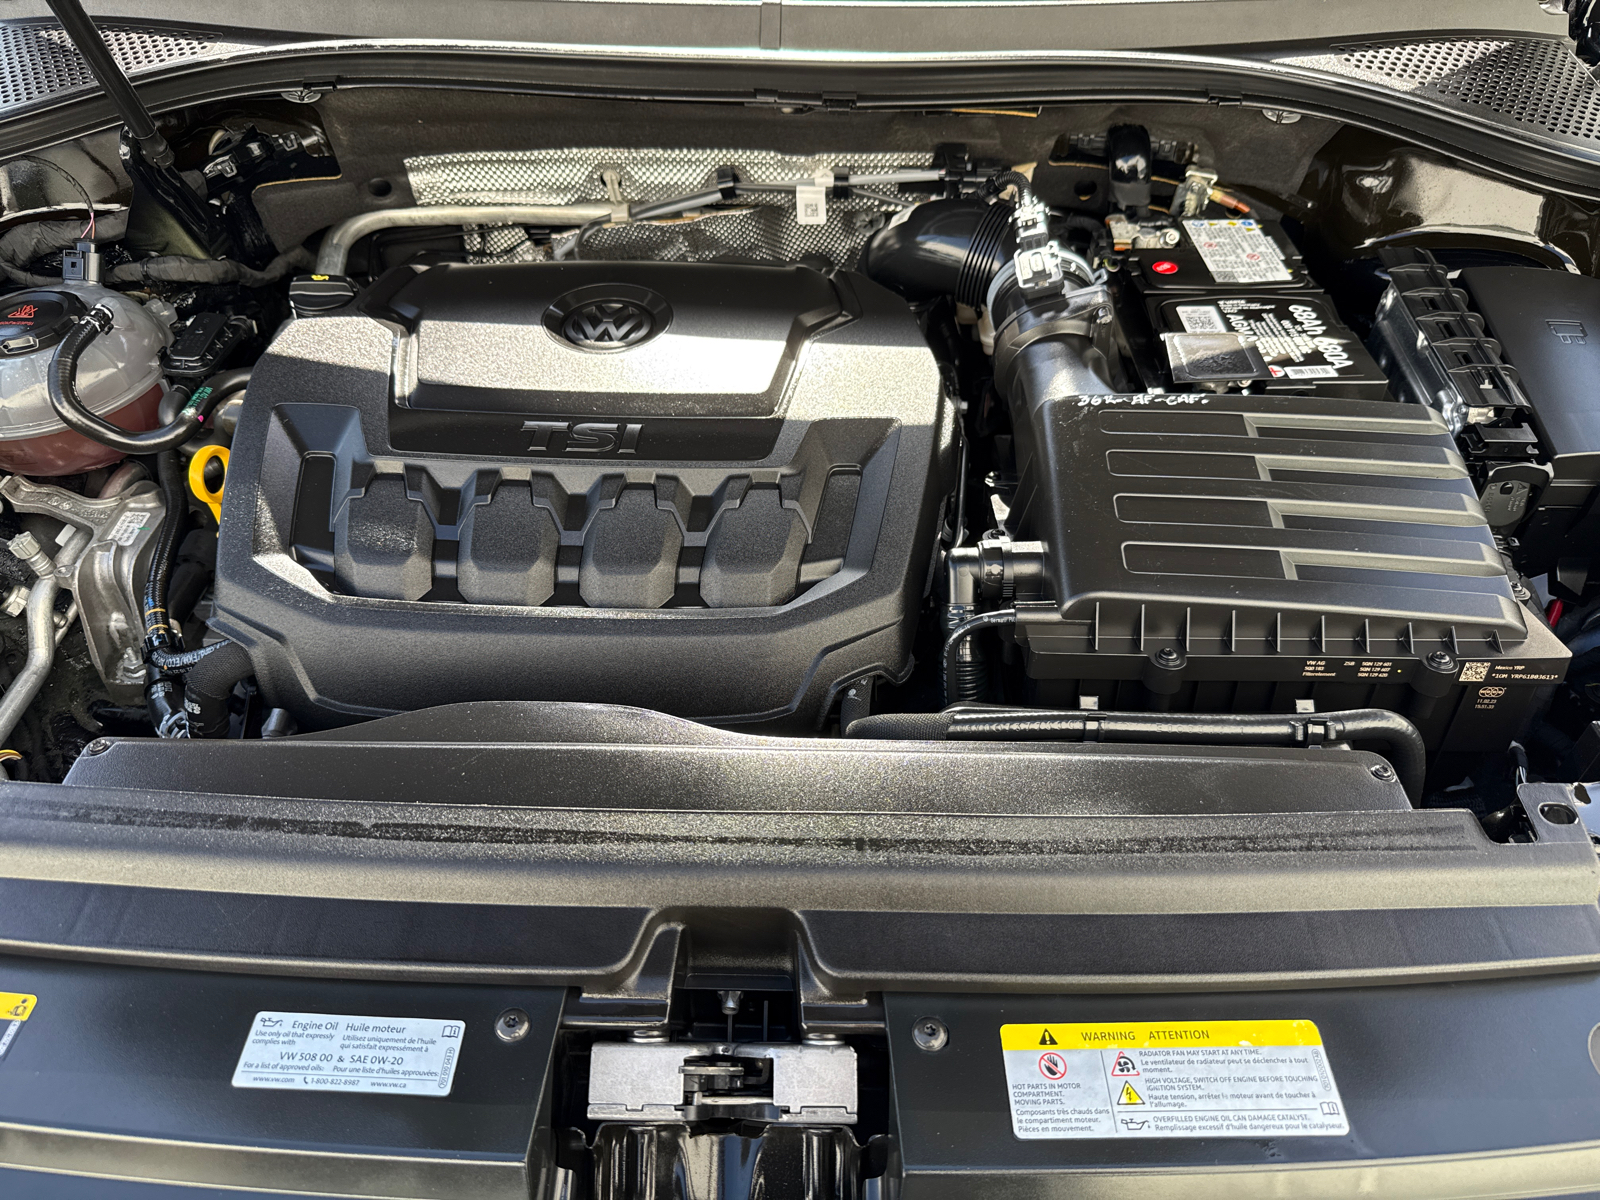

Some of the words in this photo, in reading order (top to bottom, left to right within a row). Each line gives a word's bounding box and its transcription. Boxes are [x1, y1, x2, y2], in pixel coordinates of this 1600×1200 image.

[1288, 304, 1327, 336] 68Ah
[1312, 336, 1354, 370] 680A
[520, 420, 645, 454] TSI
[292, 1020, 323, 1031] Engine
[324, 1022, 339, 1030] Oil
[346, 1023, 370, 1032] Huile
[371, 1025, 406, 1033] moteur
[268, 1030, 282, 1038] only
[305, 1032, 335, 1041] expressly
[342, 1034, 366, 1042] Utilisez
[367, 1036, 406, 1044] uniquement
[417, 1037, 436, 1045] l'huile
[1081, 1031, 1136, 1041] WARNING
[1149, 1030, 1210, 1040] ATTENTION
[252, 1038, 280, 1046] complies
[340, 1042, 351, 1050] qui
[378, 1044, 424, 1052] expressément
[280, 1052, 298, 1060] VW
[299, 1052, 318, 1061] 508
[319, 1053, 333, 1062] 00
[349, 1055, 369, 1064] SAE
[370, 1056, 404, 1065] 0W-20
[280, 1063, 310, 1071] approved
[332, 1065, 348, 1073] Pour
[376, 1067, 400, 1075] d'huiles
[401, 1069, 440, 1077] approuvées:
[310, 1077, 360, 1086] 1-800-822-8987
[1016, 1108, 1055, 1116] Composants
[1024, 1117, 1073, 1125] compartiment
[1155, 1124, 1197, 1132] Remplissage
[1249, 1123, 1284, 1131] dangereux
[1309, 1122, 1345, 1130] catalyseur.
